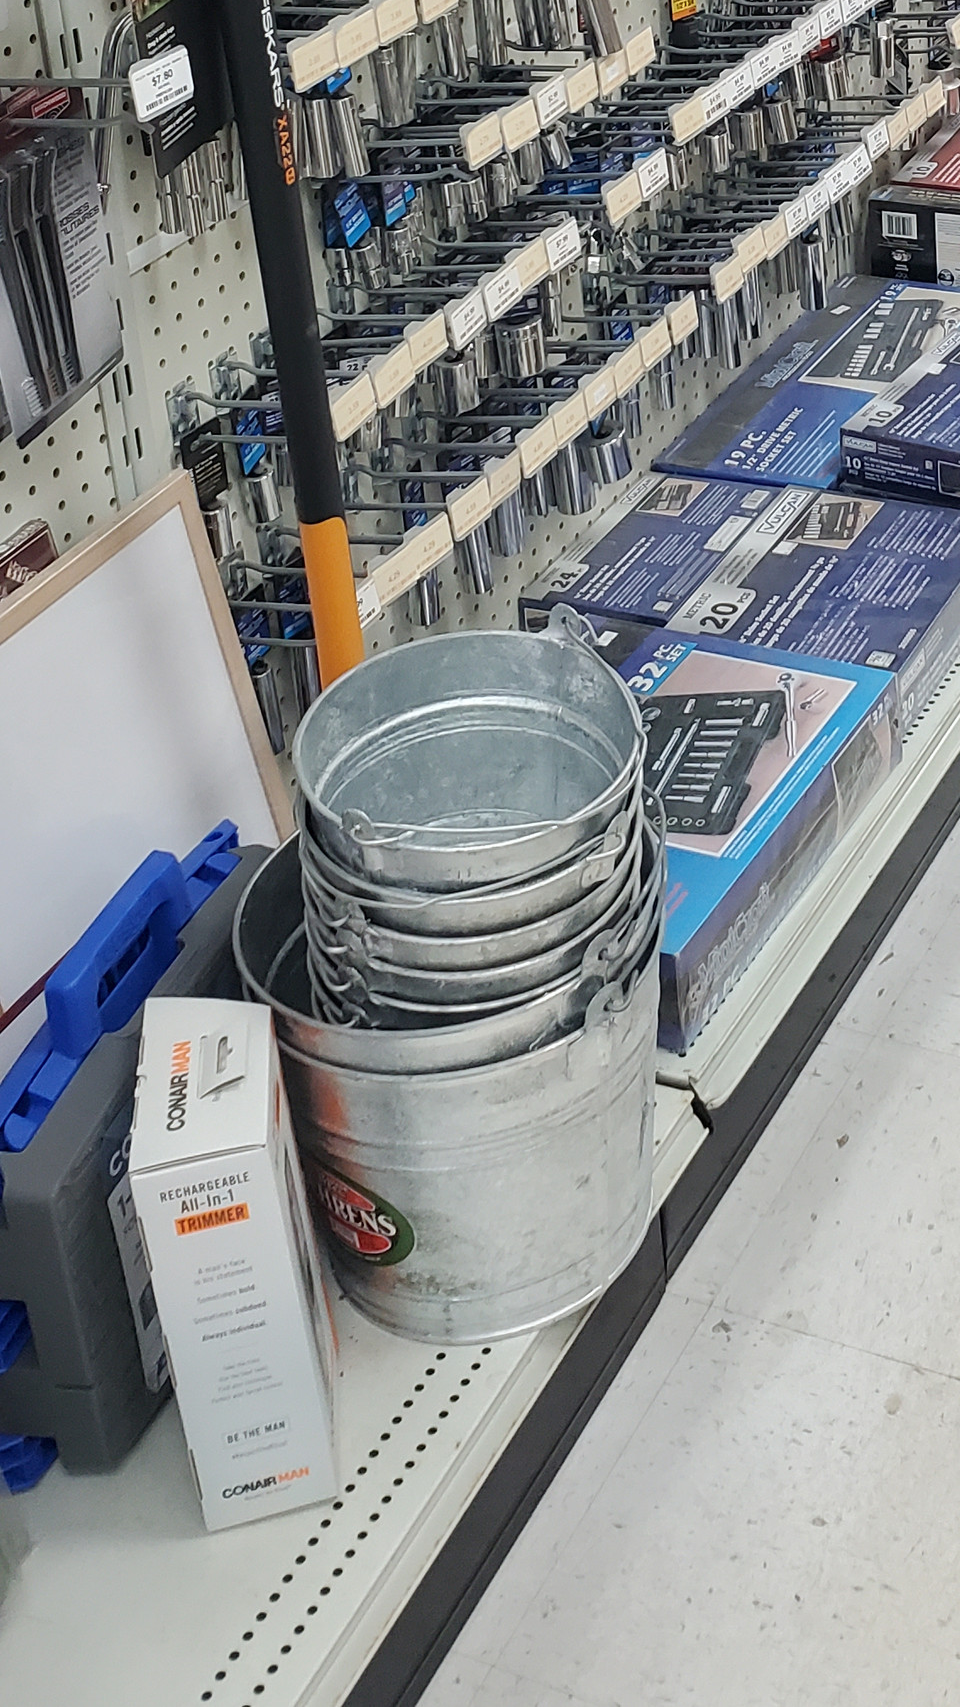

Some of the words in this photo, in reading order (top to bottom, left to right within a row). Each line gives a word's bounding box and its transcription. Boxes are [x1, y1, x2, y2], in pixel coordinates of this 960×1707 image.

[869, 410, 893, 425] 10
[724, 449, 746, 468] 19
[742, 430, 767, 450] PC.
[742, 455, 758, 471] 1/2"
[759, 432, 783, 455] DRIVE
[778, 407, 804, 434] METRIC
[755, 445, 784, 473] SOCKET
[782, 430, 797, 446] SET
[845, 455, 862, 470] 10
[763, 493, 804, 533] VULCAN
[551, 571, 578, 589] 24
[683, 592, 712, 619] METRIC
[700, 602, 739, 630] 20
[667, 643, 688, 663] SET
[628, 661, 669, 692] 32
[160, 1171, 250, 1203] RECHARGEABLE
[181, 1189, 235, 1214] All-In-1
[177, 1205, 246, 1235] TRIMMER
[202, 1329, 228, 1342] Always
[227, 1434, 240, 1444] BE
[243, 1427, 261, 1440] THE
[264, 1420, 286, 1433] MAN
